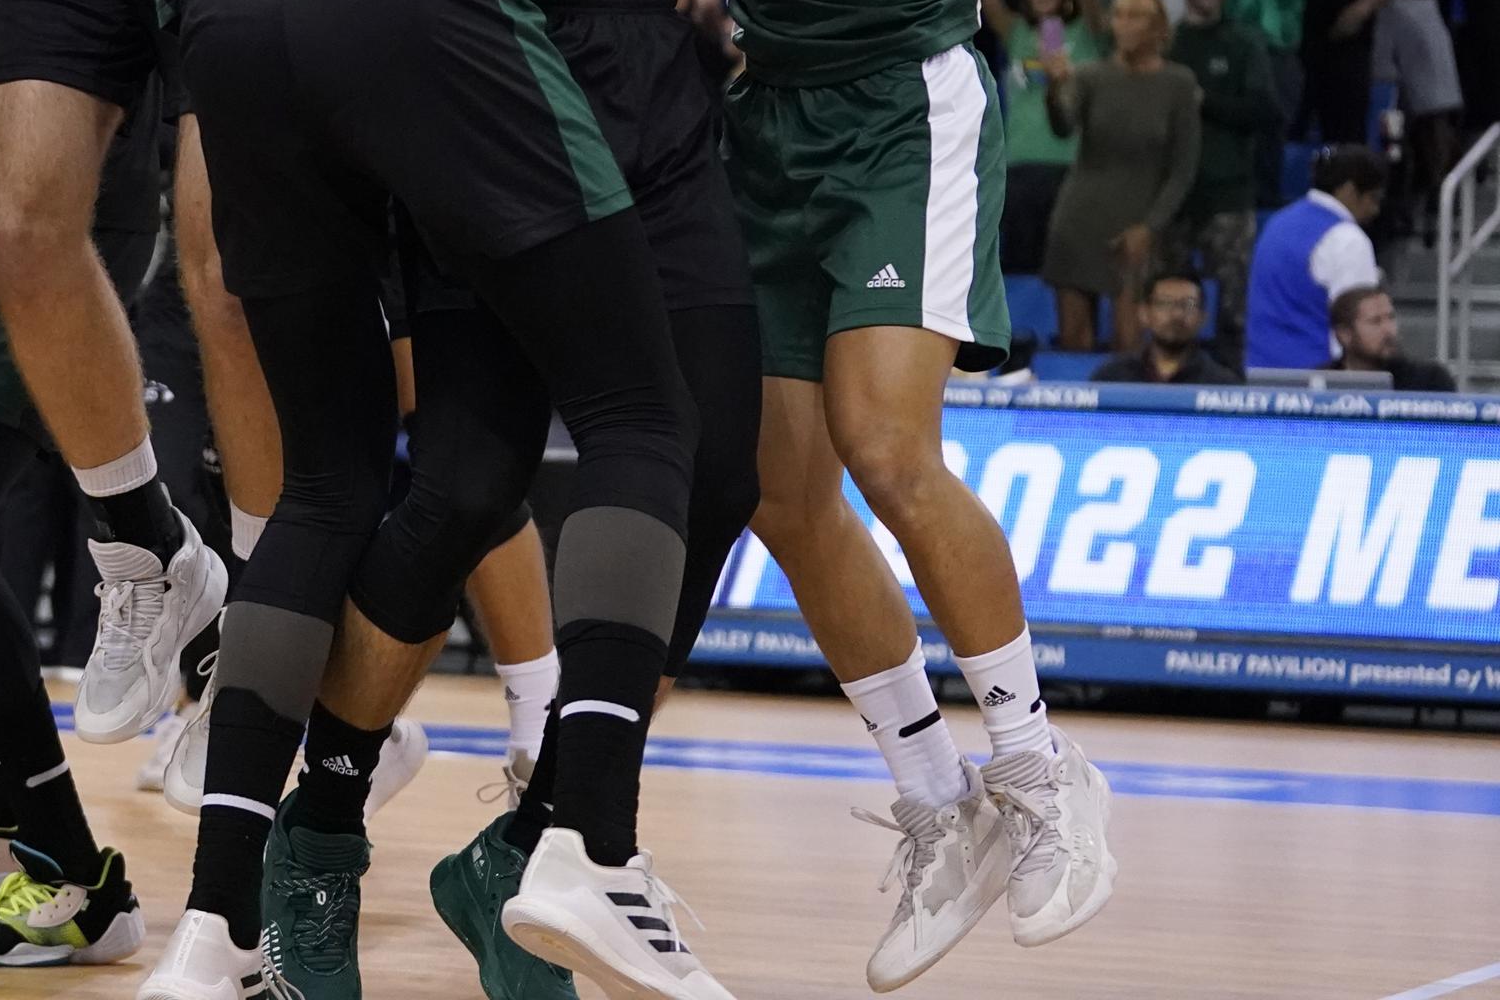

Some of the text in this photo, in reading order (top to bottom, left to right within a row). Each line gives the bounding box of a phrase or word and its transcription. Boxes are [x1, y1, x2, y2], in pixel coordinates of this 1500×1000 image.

[1196, 390, 1269, 413] PAULEY
[1288, 453, 1500, 612] ME
[1165, 650, 1242, 674] PAULEY
[1246, 653, 1347, 681] PAVILION
[1350, 662, 1451, 688] presented
[983, 692, 1017, 707] adidas
[322, 758, 359, 776] adidas
